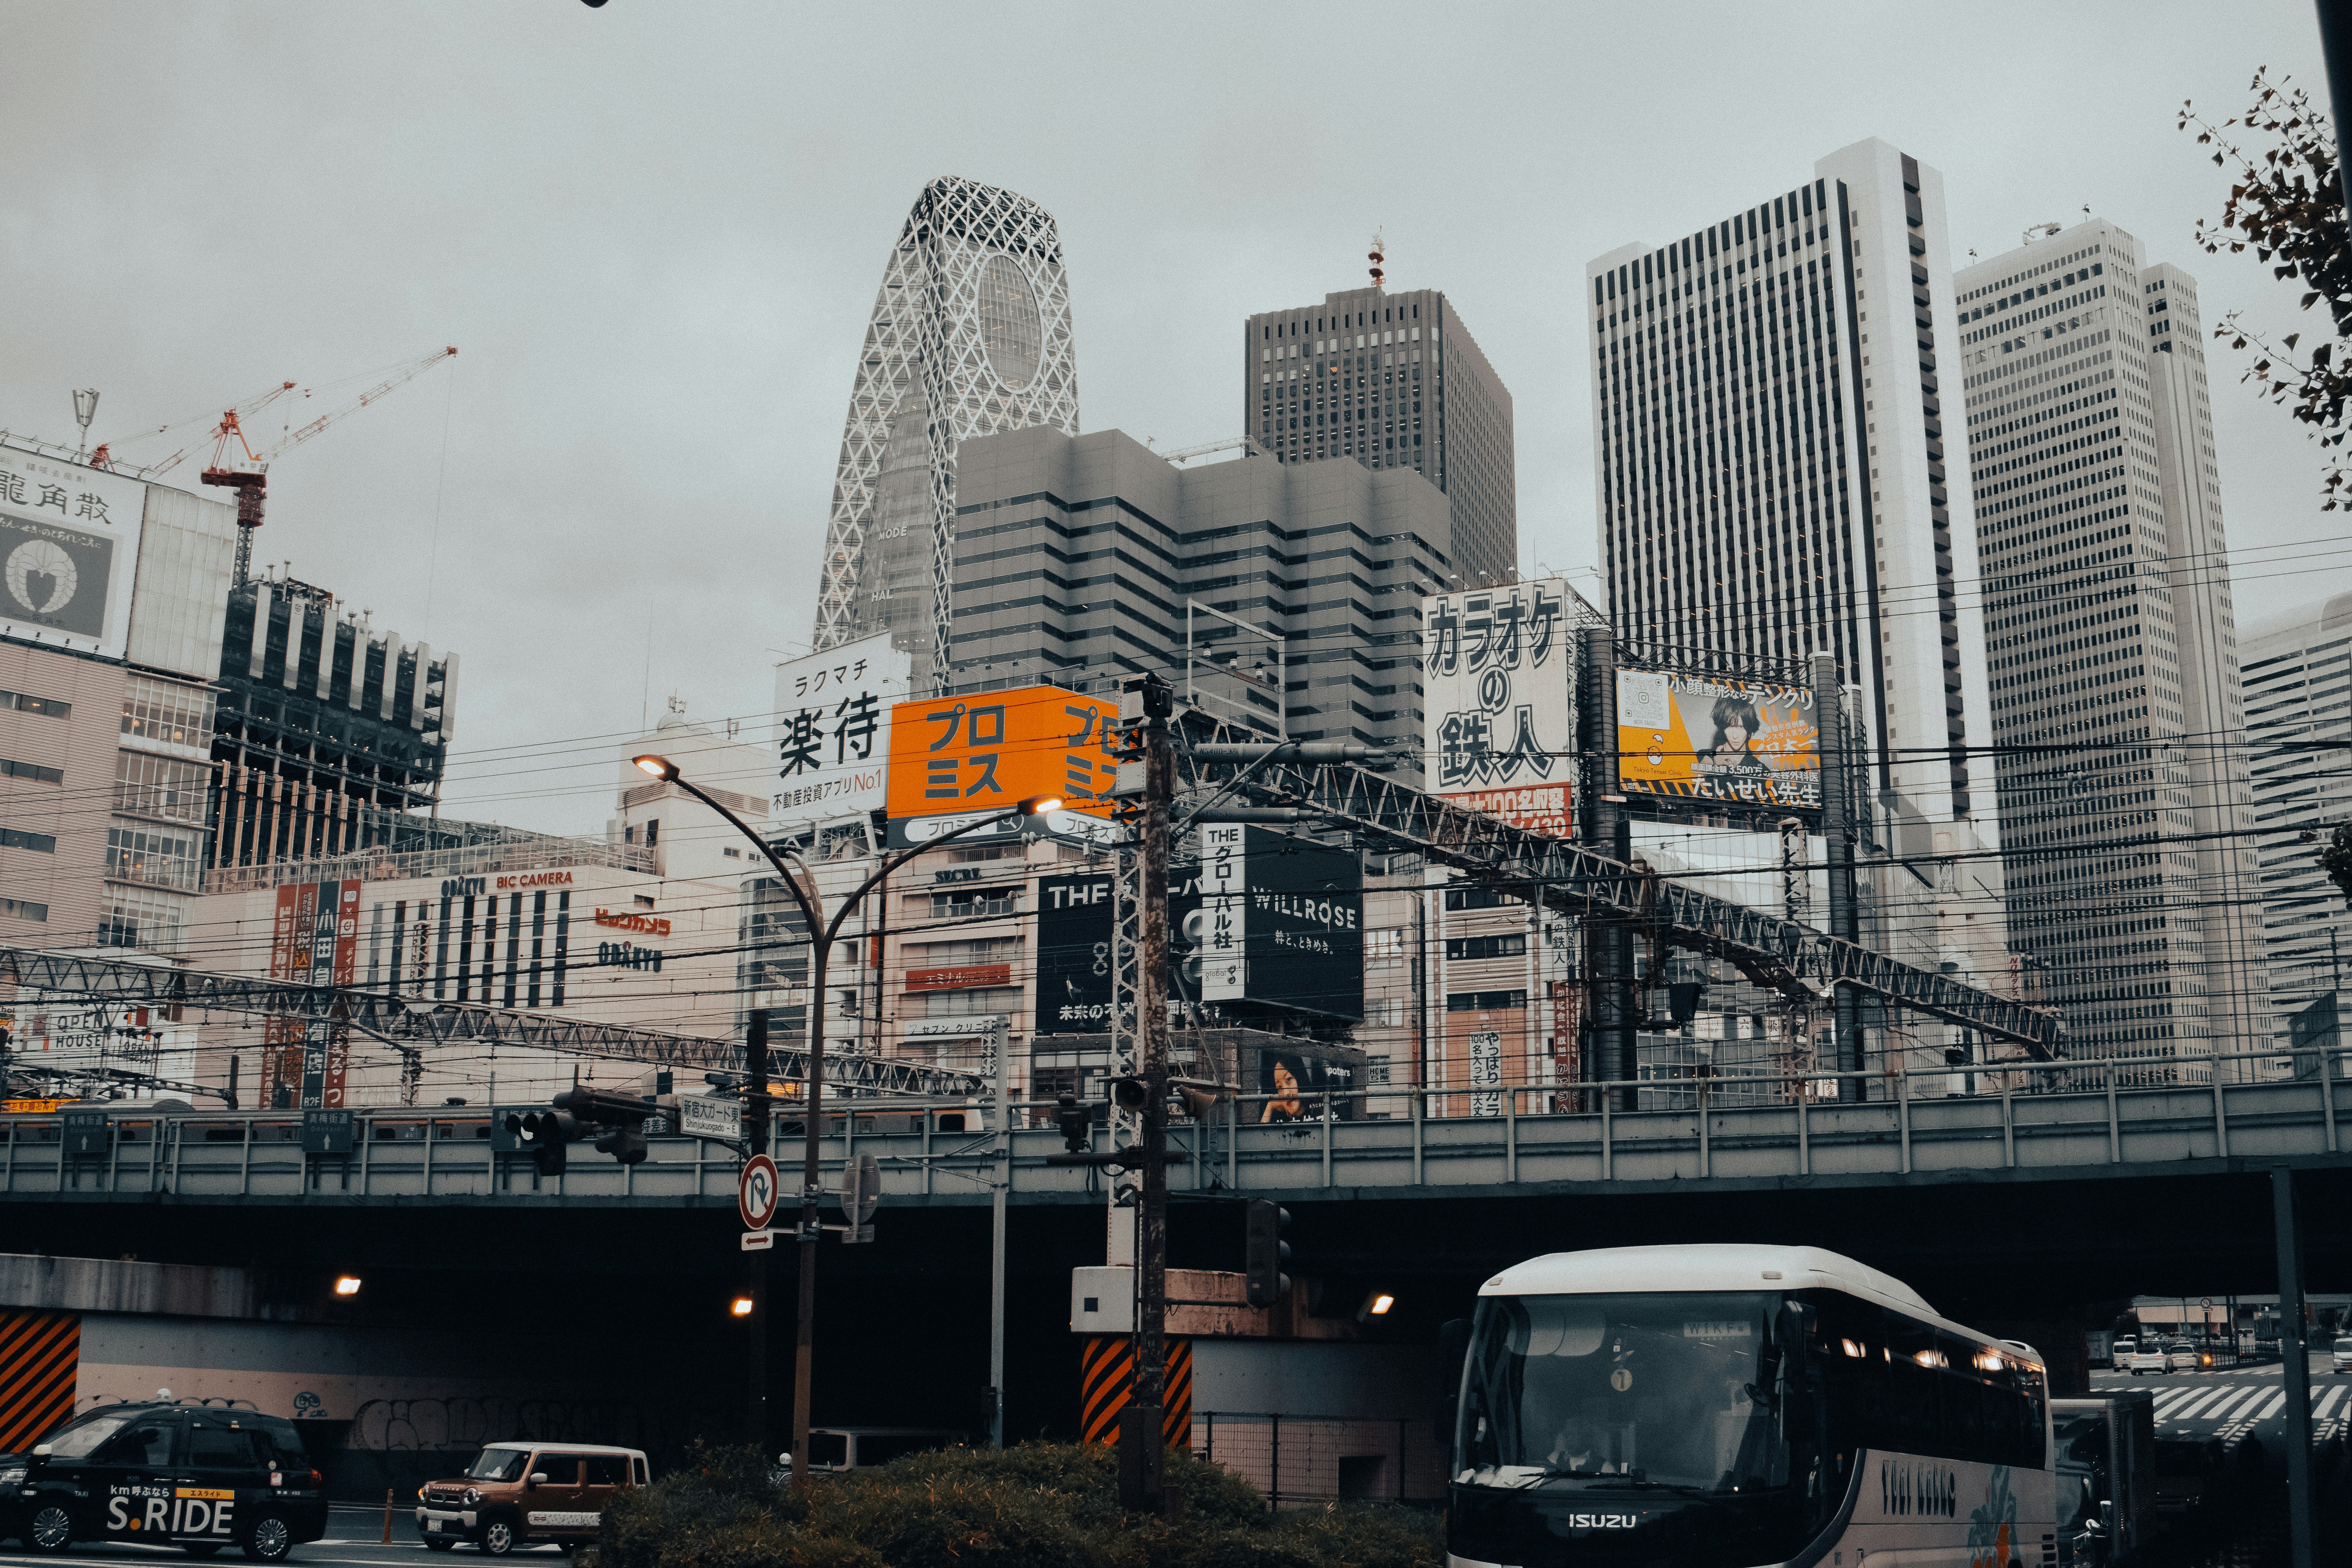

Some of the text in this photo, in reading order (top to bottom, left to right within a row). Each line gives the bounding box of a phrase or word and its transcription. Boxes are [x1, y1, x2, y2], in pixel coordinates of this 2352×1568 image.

[879, 526, 907, 541] MODE
[1426, 584, 1562, 680] カラオケ
[795, 659, 867, 698] ラクマチ
[1478, 665, 1512, 716] の
[1670, 677, 1813, 710] 小顔整形ならテンクリ
[779, 691, 880, 779] 楽待
[927, 703, 1005, 752] プロ
[1437, 704, 1555, 787] 鉄人
[925, 753, 1004, 799] ミス
[1691, 774, 1821, 806] たいせい先生
[1209, 829, 1238, 843] THE
[441, 877, 486, 897] ODAKYU
[497, 871, 573, 889] BIC CAMERA
[1049, 884, 1109, 908] THE
[1214, 846, 1232, 950] グローバル社
[1253, 886, 1356, 929] WILLROSE
[595, 907, 671, 936] ビックカメラ
[598, 942, 662, 973] ODAKYU
[56, 1034, 101, 1048] HOUSE
[1328, 1067, 1350, 1077] paters
[304, 1098, 320, 1107] B2F
[684, 1099, 739, 1123] 新宿大ガード東
[309, 1112, 348, 1125] 青梅街道
[686, 1118, 724, 1133] Shinjukuogado
[107, 1496, 234, 1533] S.RIDE
[1569, 1514, 1636, 1528] ISUZU
